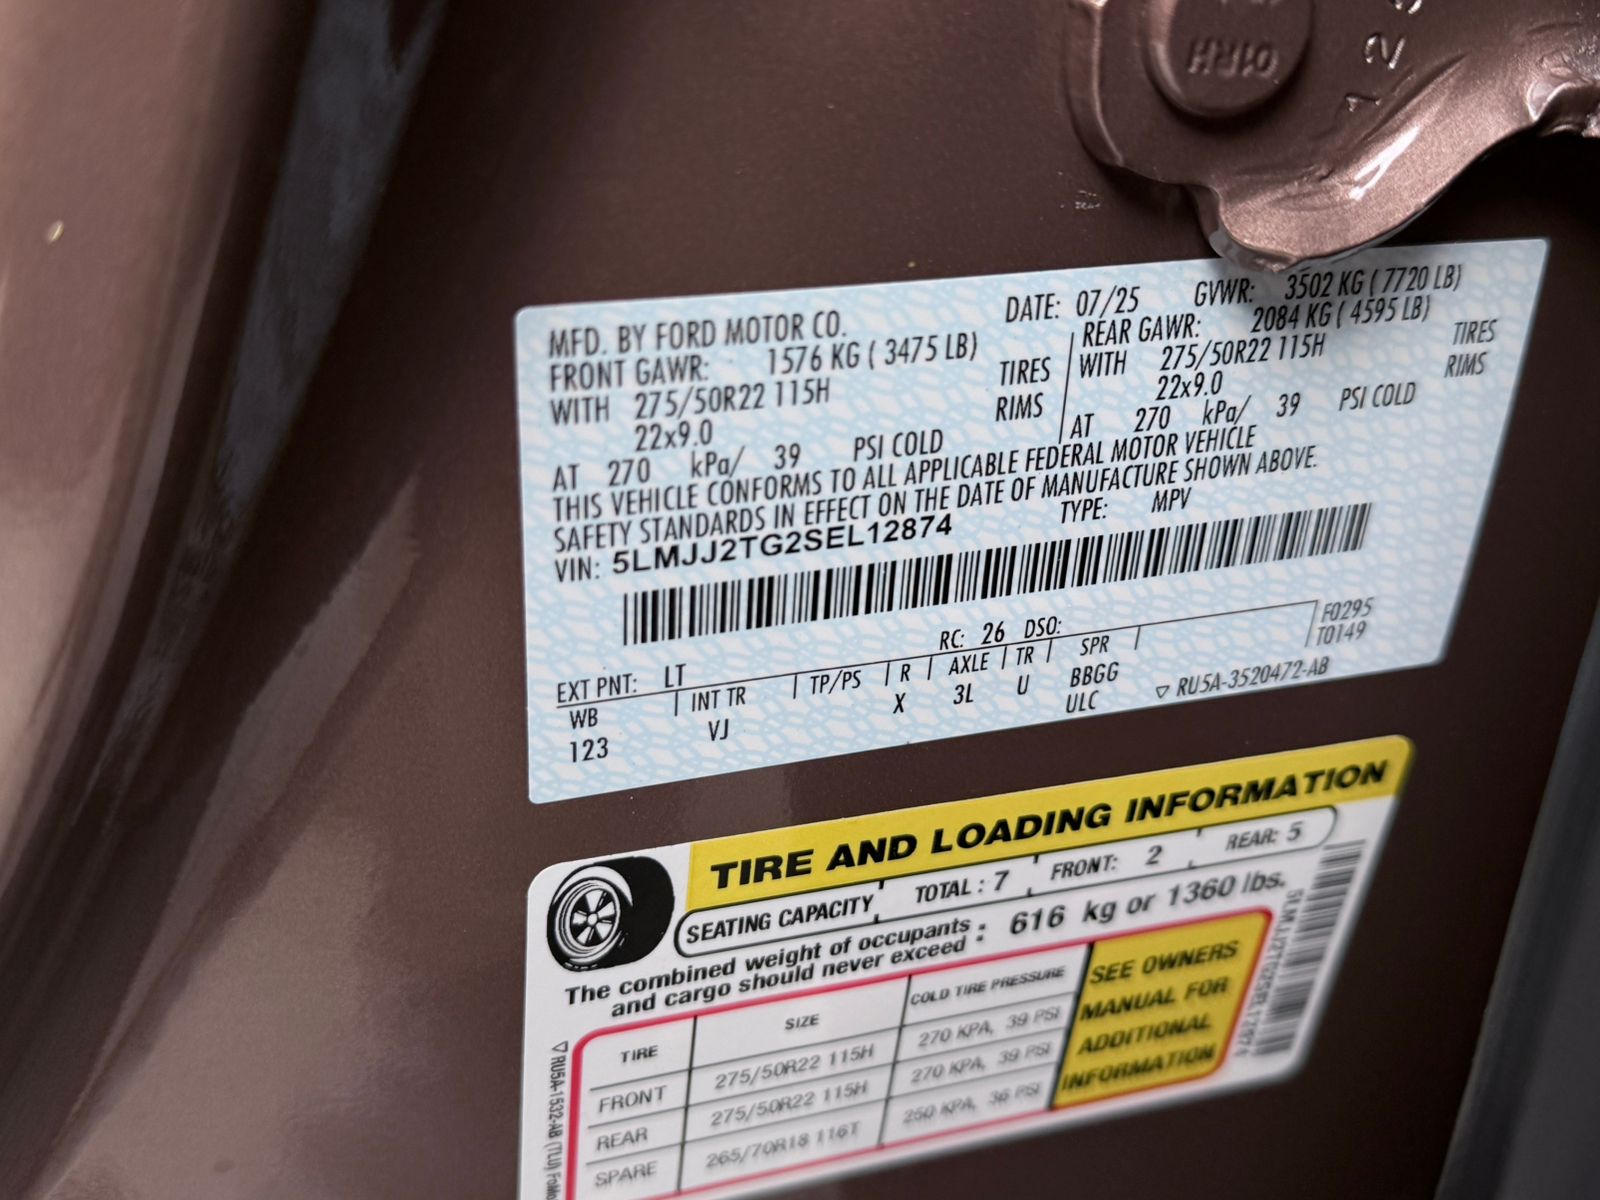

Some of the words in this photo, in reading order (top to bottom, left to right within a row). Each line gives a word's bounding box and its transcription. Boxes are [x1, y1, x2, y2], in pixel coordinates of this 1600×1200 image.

[1194, 278, 1255, 307] GVWR:
[1284, 270, 1334, 300] 3502
[1337, 270, 1365, 297] KG
[1381, 265, 1429, 293] 7720
[1433, 263, 1463, 292] LB)
[1005, 293, 1061, 323] DATE:
[1076, 285, 1140, 319] 07/25
[1082, 318, 1132, 348] REAR
[1138, 313, 1202, 343] GAWR:
[1251, 305, 1300, 333] 2084
[1305, 301, 1332, 329] KG
[1350, 297, 1397, 324] 4595
[1402, 294, 1431, 322] LB)
[550, 327, 607, 359] MFD.
[618, 324, 646, 353] BY
[656, 320, 716, 351] FORD
[724, 313, 804, 345] MOTOR
[813, 310, 847, 339] CO.
[1452, 318, 1498, 346] TIRES
[551, 360, 627, 392] FRONT
[635, 354, 709, 386] GAWR:
[767, 344, 822, 375] 1576
[831, 341, 860, 370] KG
[884, 334, 938, 365] 3475
[946, 331, 978, 361] LB)
[1000, 356, 1051, 386] TIRES
[1079, 350, 1127, 378] WITH
[1160, 337, 1271, 371] 275/50R22
[1278, 332, 1326, 360] 115H
[1444, 351, 1488, 378] RIMS
[551, 397, 610, 426] WITH
[635, 382, 765, 420] 275/50R22
[776, 377, 830, 407] 115H
[1155, 370, 1223, 401] 22x9.0
[995, 392, 1044, 422] RIMS
[1069, 413, 1095, 439] AT
[1133, 405, 1171, 433] 270
[1202, 395, 1251, 425] kPa/
[1276, 392, 1301, 418] 39
[1338, 386, 1367, 411] PSI
[1372, 382, 1417, 408] COLD
[635, 419, 713, 452] 22x9.0
[553, 463, 580, 492] AT
[608, 457, 651, 487] 270
[691, 445, 745, 478] kPa/
[774, 443, 800, 471] 39
[853, 434, 884, 462] PSI
[892, 429, 943, 458] COLD
[553, 493, 601, 522] THIS
[611, 484, 698, 516] VEHICLE
[707, 470, 822, 506] CONFORMS
[831, 467, 855, 493] TO
[862, 463, 896, 490] ALL
[904, 450, 1018, 485] APPLICABLE
[1025, 441, 1104, 472] FEDERAL
[1111, 433, 1178, 462] MOTOR
[1185, 424, 1257, 454] VEHICLE
[555, 520, 632, 553] SAFETY
[640, 506, 765, 543] STANDARDS
[774, 504, 795, 529] IN
[804, 494, 871, 525] EFFECT
[878, 491, 906, 517] ON
[915, 486, 950, 512] THE
[957, 480, 1005, 508] DATE
[1011, 476, 1036, 502] OF
[1041, 460, 1179, 498] MANUFACTURE
[1183, 453, 1252, 482] SHOWN
[1255, 444, 1317, 475] ABOVE.
[1061, 497, 1108, 524] TYPE:
[1151, 487, 1192, 513] MPV
[555, 556, 600, 583] VIN:
[613, 513, 952, 574] 5LMJJ2TG2SEL12874
[940, 629, 964, 650] RC:
[981, 622, 1005, 645] 26
[1024, 616, 1062, 639] DSO:
[1080, 635, 1110, 656] SPR
[900, 664, 910, 682] R
[949, 652, 990, 675] AXLE
[1016, 647, 1034, 665] TR
[1070, 661, 1119, 687] BBGG
[557, 678, 591, 703] EXT
[597, 673, 637, 698] PNT:
[665, 664, 686, 688] LT
[810, 670, 862, 695] TP/PS
[953, 683, 974, 705] 3L
[1017, 674, 1030, 695] U
[1176, 655, 1329, 697] RU5A-3520472-AB
[692, 690, 720, 712] INT
[727, 687, 746, 706] TR
[893, 693, 905, 714] X
[1065, 690, 1099, 713] ULC
[570, 708, 598, 729] WB
[709, 719, 729, 741] VJ
[570, 737, 608, 763] 123
[710, 849, 814, 890] TIRE
[825, 834, 917, 871] AND
[931, 804, 1111, 854] LOADING
[1125, 760, 1389, 822] INFORMATION
[1225, 827, 1279, 851] REAR:
[1287, 821, 1304, 842] 5
[994, 870, 1010, 892] 7
[1050, 854, 1119, 881] FRONT:
[1145, 845, 1164, 866] 2
[686, 909, 772, 945] SEATING
[778, 894, 874, 928] CAPACITY
[1009, 905, 1065, 936] 616
[1082, 897, 1116, 924] kg
[1125, 891, 1155, 915] or
[1167, 874, 1236, 907] 1360
[1241, 869, 1285, 894] lbs.
[564, 984, 611, 1005] The
[619, 957, 736, 995] combined
[744, 940, 821, 972] weight
[830, 934, 851, 956] of
[1090, 958, 1135, 985] SEE
[1141, 940, 1240, 975] OWNERS
[611, 993, 656, 1017] and
[664, 982, 731, 1008] cargo
[738, 956, 815, 993] should
[822, 951, 886, 976] never
[910, 988, 950, 1005] COLD
[956, 981, 986, 997] TIRE
[991, 965, 1066, 989] PRESSURE
[1080, 988, 1176, 1022] MANUAL
[1184, 976, 1230, 1001] FOR
[784, 1014, 819, 1031] SIZE
[918, 1028, 952, 1048] 270
[1006, 1014, 1029, 1030] 39
[1033, 1006, 1062, 1023] PSI
[1077, 1013, 1212, 1055] ADDITIONAL
[621, 1045, 658, 1063] TIRE
[714, 1055, 820, 1090] 275/50R22
[828, 1043, 875, 1067] 115H
[911, 1064, 944, 1083] 270
[998, 1048, 1019, 1064] 39
[1024, 1041, 1053, 1059] PSI
[1061, 1043, 1216, 1091] INFORMATION
[548, 1055, 566, 1138] RU5A-1532-AB
[599, 1085, 667, 1113] FRONT
[710, 1092, 815, 1127] 275/50R22
[823, 1080, 869, 1103] 115H
[1015, 1081, 1042, 1097] PSI
[597, 1127, 648, 1151] REAR
[816, 1121, 862, 1145] 116T
[595, 1161, 657, 1188] SPARE
